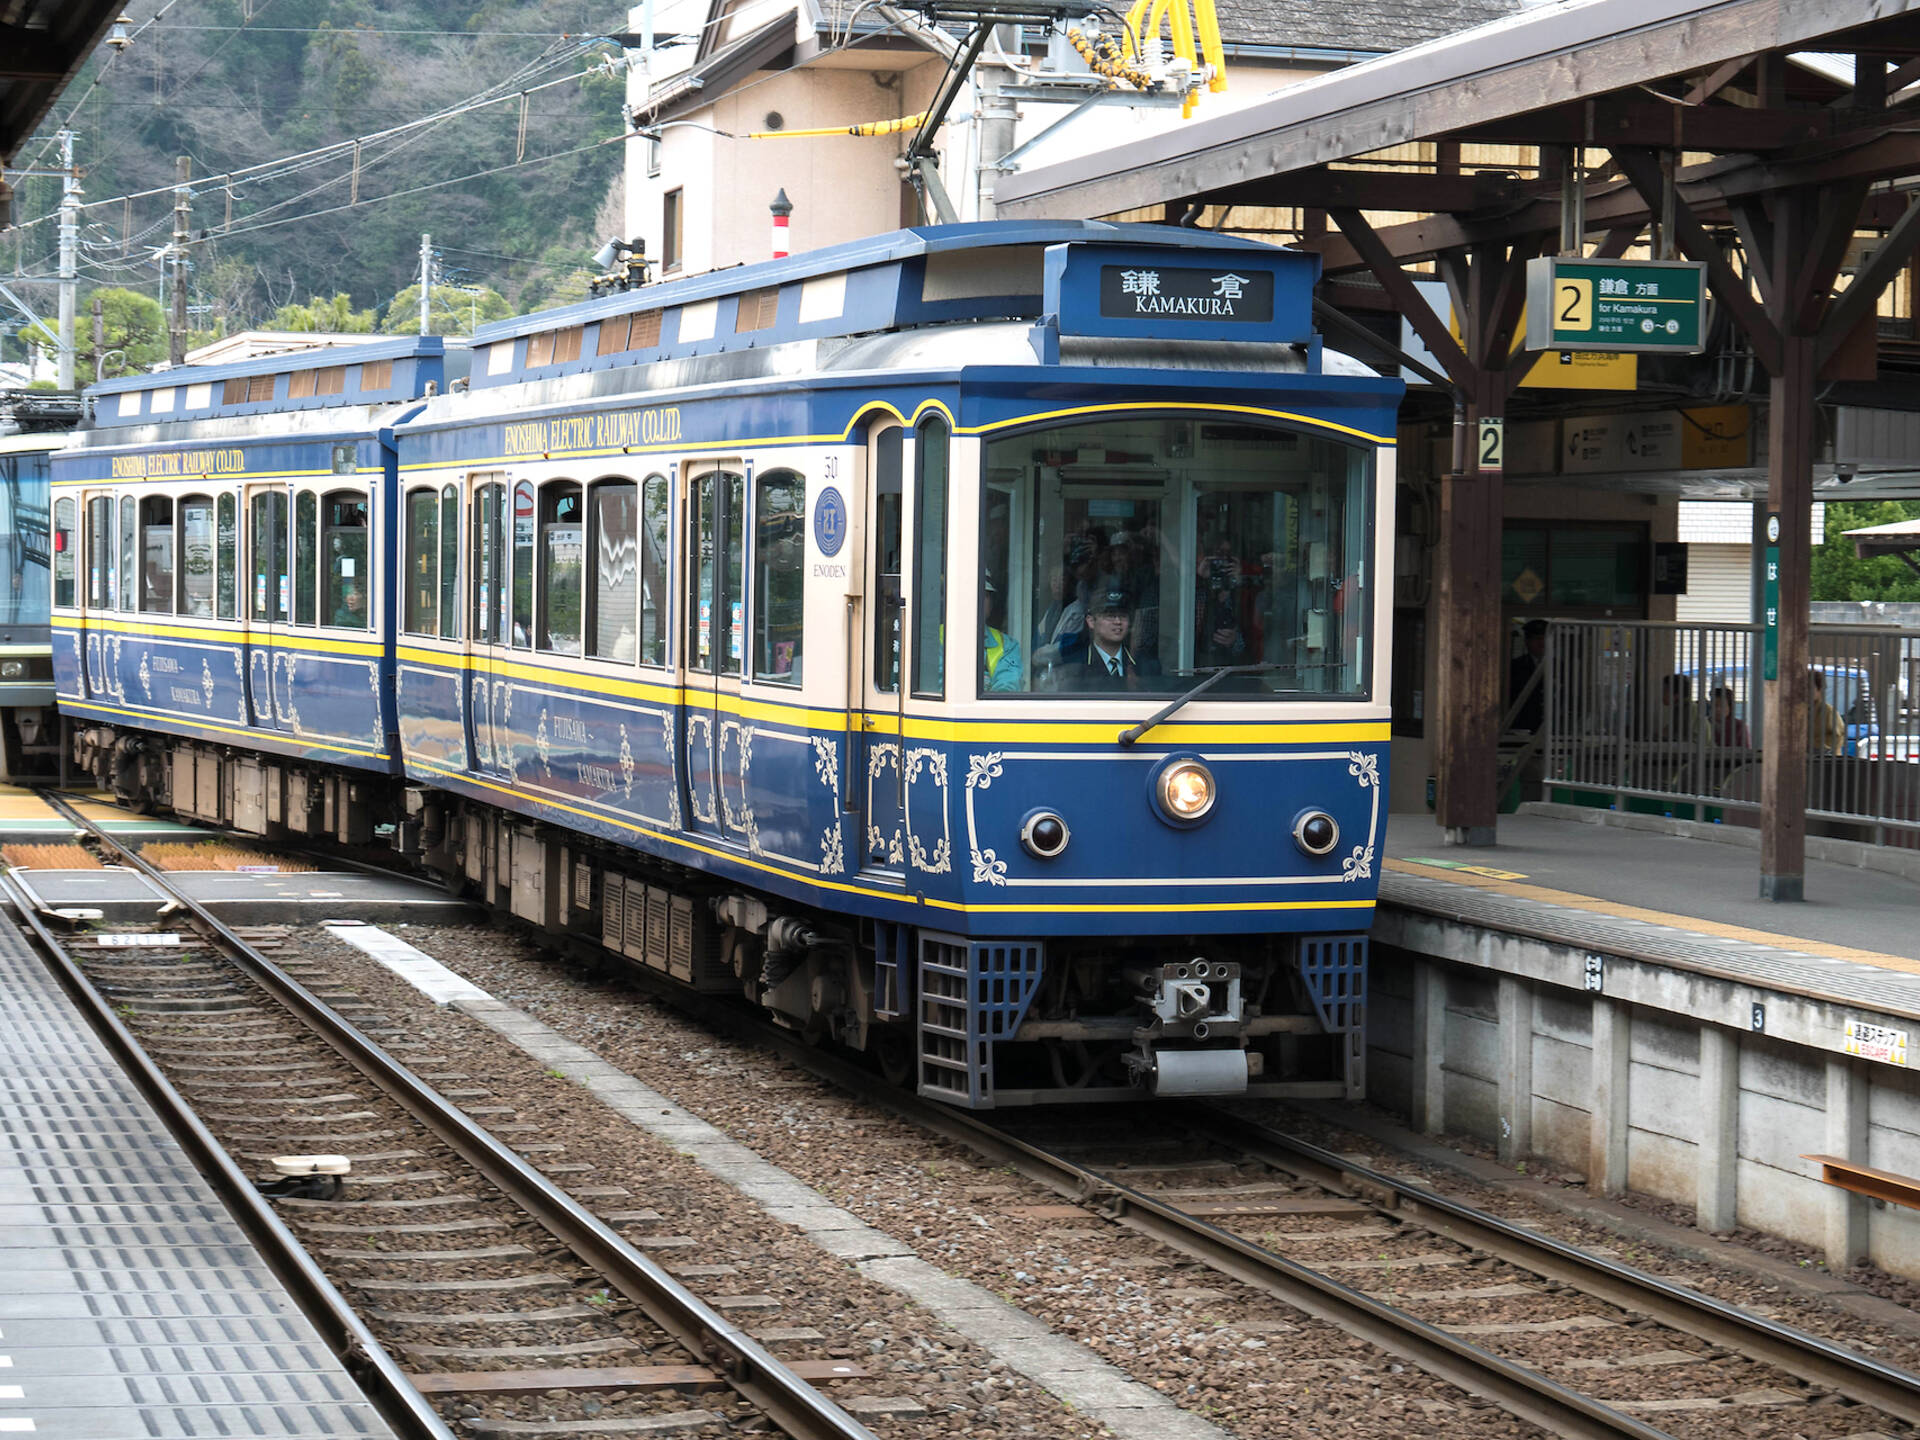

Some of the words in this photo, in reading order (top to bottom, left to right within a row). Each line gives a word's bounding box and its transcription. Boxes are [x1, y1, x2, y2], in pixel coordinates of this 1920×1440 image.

[1599, 278, 1629, 295] 鎌倉
[1635, 282, 1659, 296] 方面
[1135, 296, 1234, 315] KAMAKURA
[1561, 285, 1581, 322] 2
[1598, 303, 1612, 314] for
[1612, 304, 1658, 315] Kamakura
[505, 423, 547, 454] ENOSHIMA
[550, 416, 594, 450] ELECTRIC
[596, 411, 641, 446] RAILWAY
[1481, 427, 1500, 464] 2
[813, 564, 847, 578] ENODEN
[1766, 562, 1778, 627] はせ
[1753, 1008, 1764, 1029] 3
